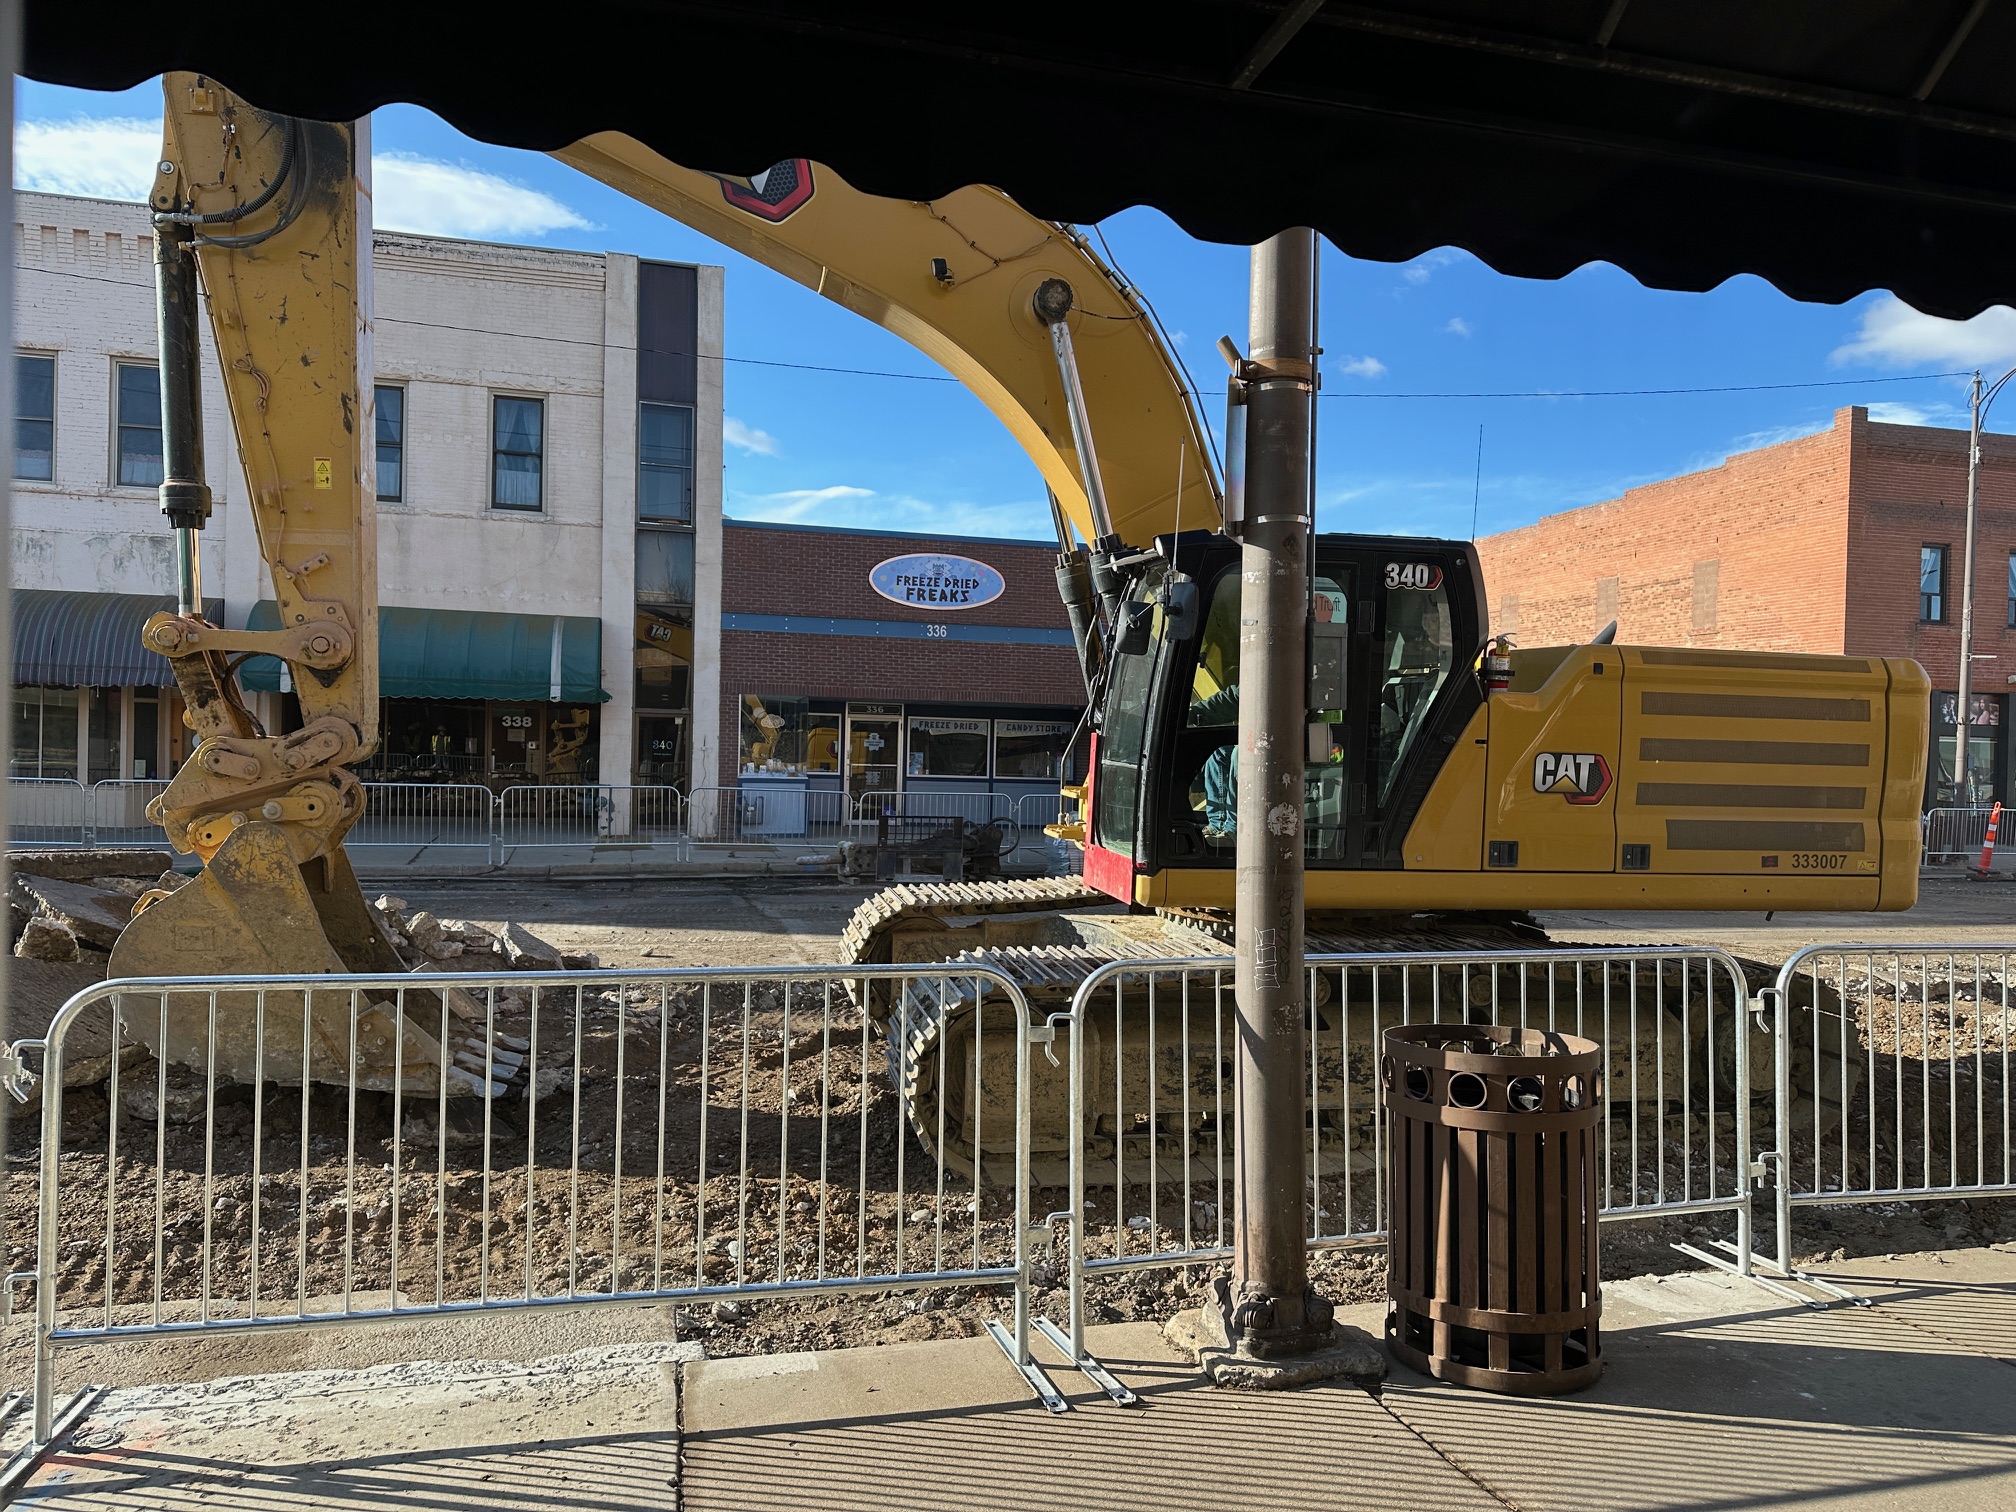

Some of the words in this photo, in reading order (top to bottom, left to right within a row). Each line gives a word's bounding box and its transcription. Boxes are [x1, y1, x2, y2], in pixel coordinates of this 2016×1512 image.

[1386, 563, 1429, 587] 340
[896, 575, 940, 588] FREEZE
[944, 578, 979, 590] DRIED
[906, 587, 970, 603] FREAKS
[926, 625, 947, 638] 336
[866, 705, 884, 714] 336
[501, 715, 532, 728] 338
[919, 720, 951, 729] FREEZE
[954, 721, 979, 731] DRIED
[1006, 723, 1034, 732] CANDY
[1035, 724, 1062, 733] STORE
[652, 739, 673, 750] 340
[1534, 753, 1595, 793] CAT
[1792, 854, 1848, 869] 333007
